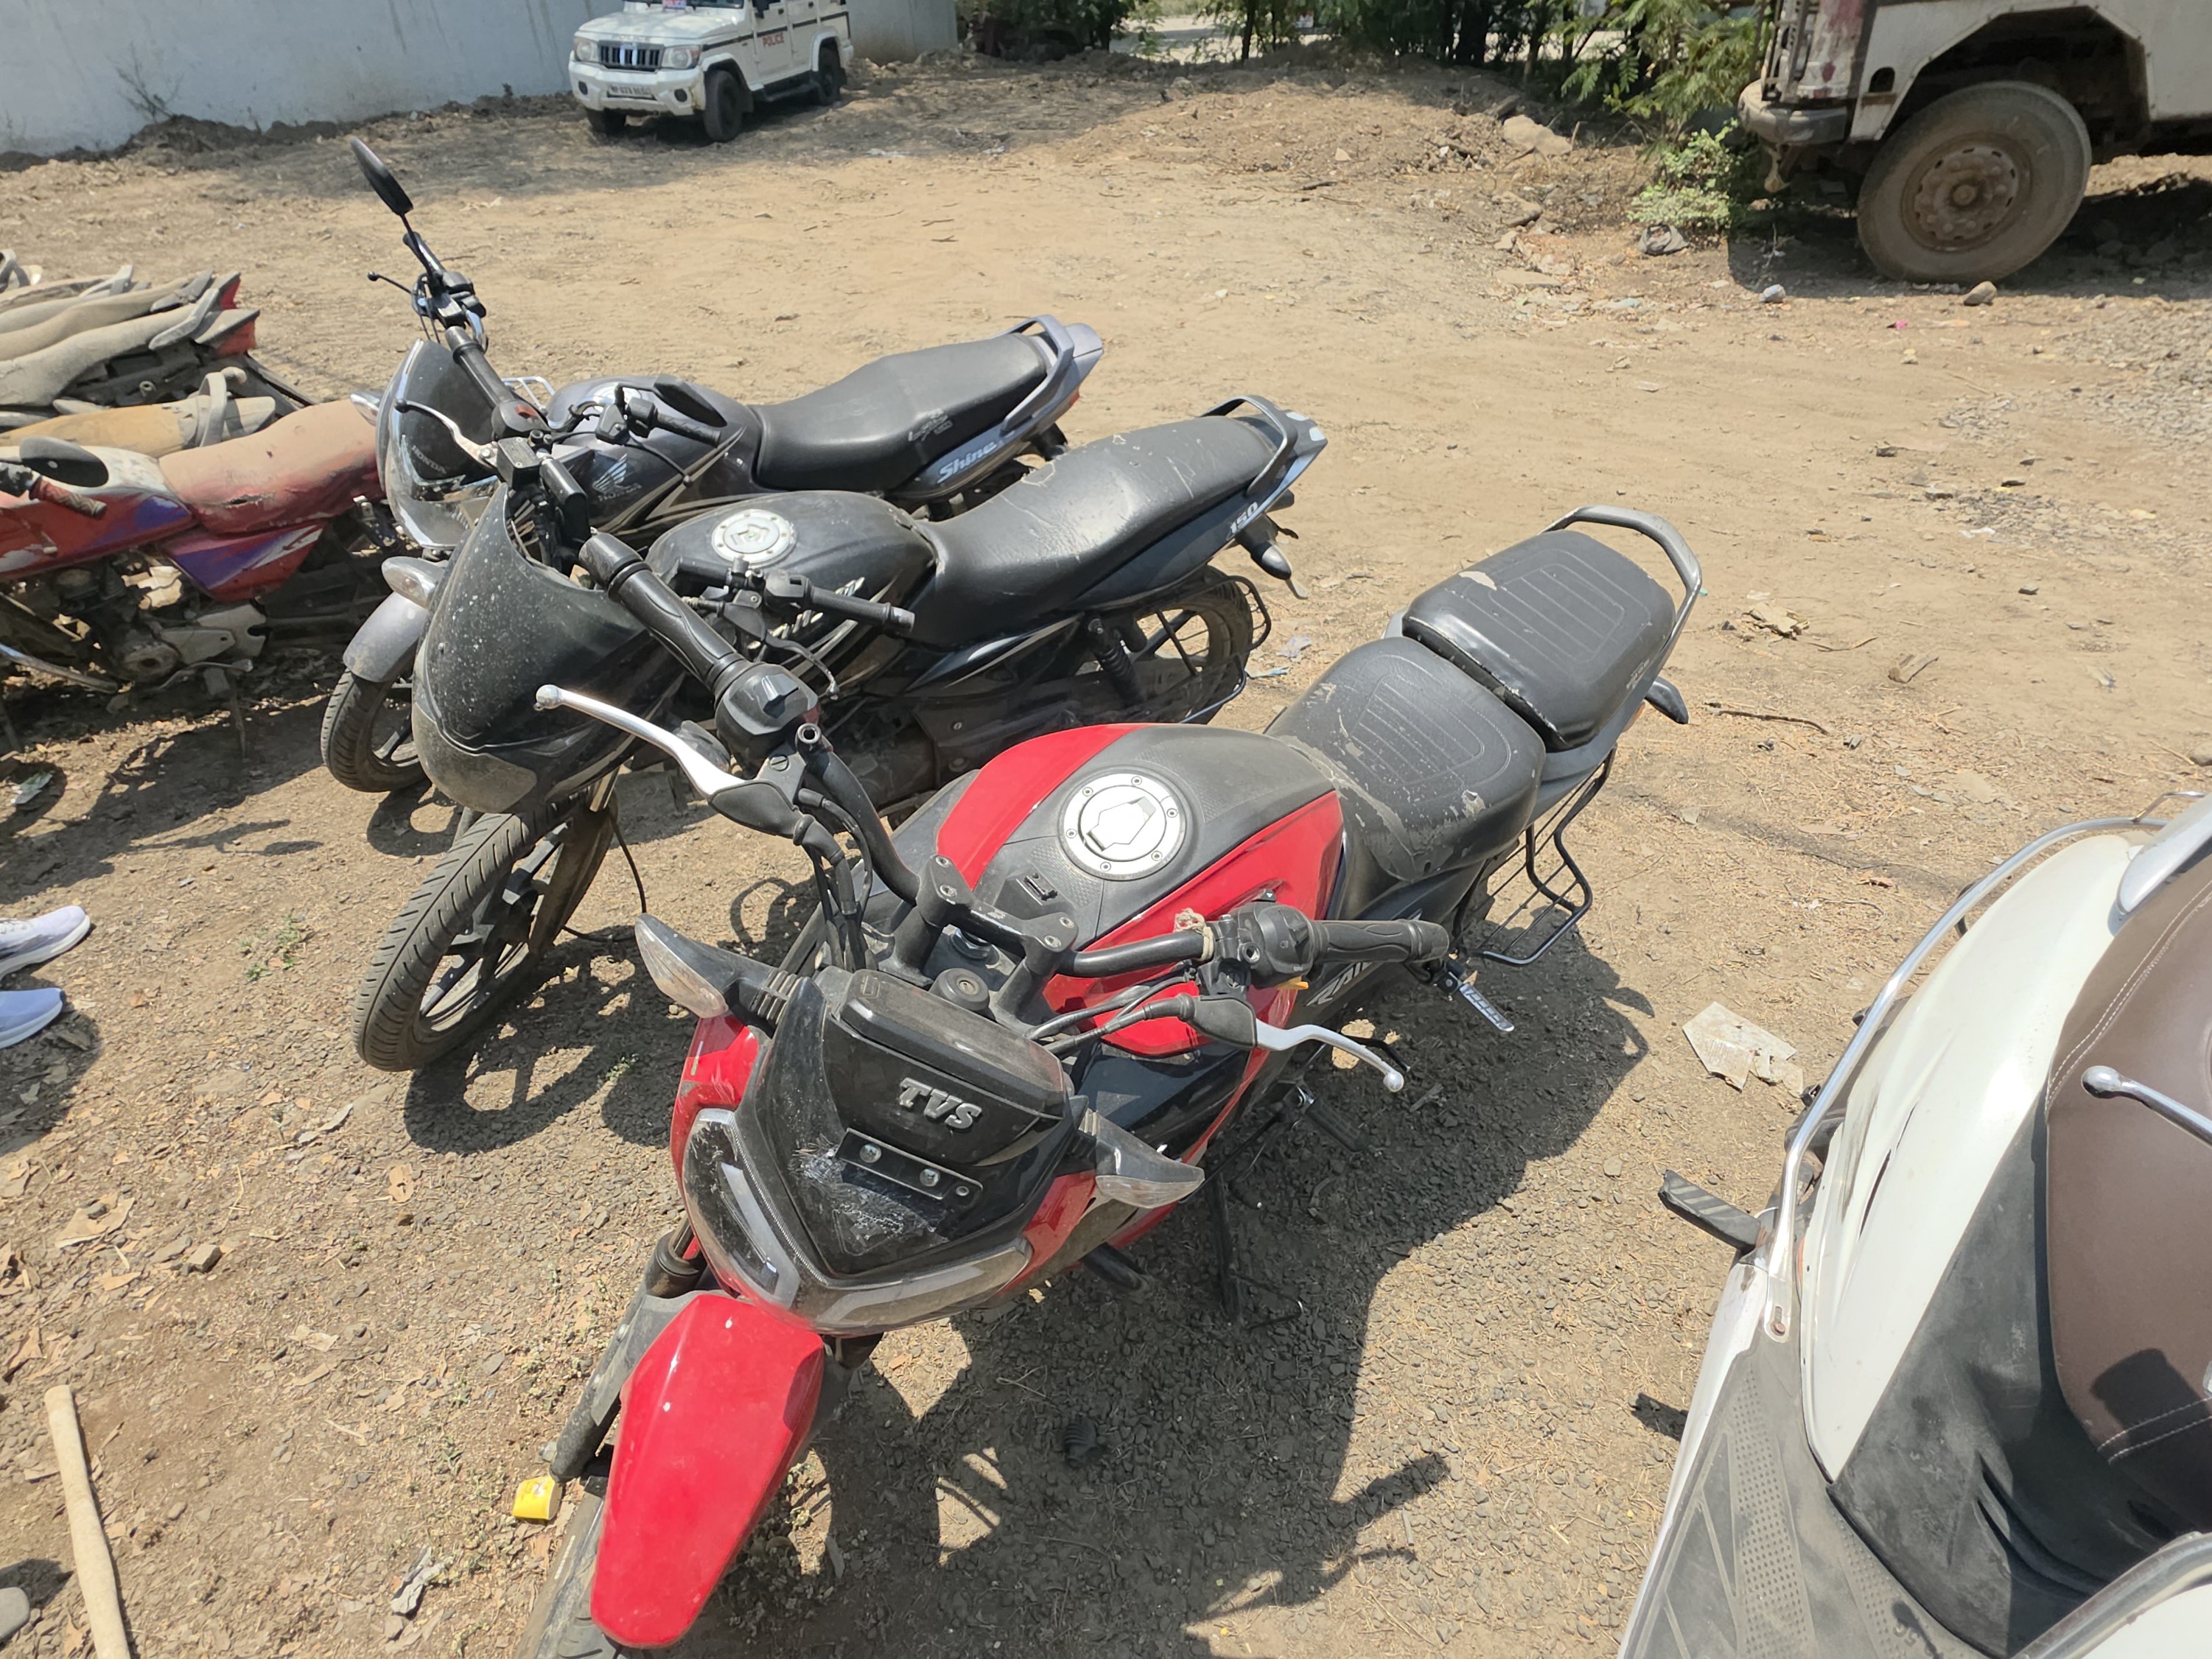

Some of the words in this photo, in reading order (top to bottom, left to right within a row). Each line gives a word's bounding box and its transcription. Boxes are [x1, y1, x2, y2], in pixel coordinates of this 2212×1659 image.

[937, 441, 998, 484] Shine
[1230, 501, 1259, 534] 150
[898, 1077, 983, 1129] TVS
